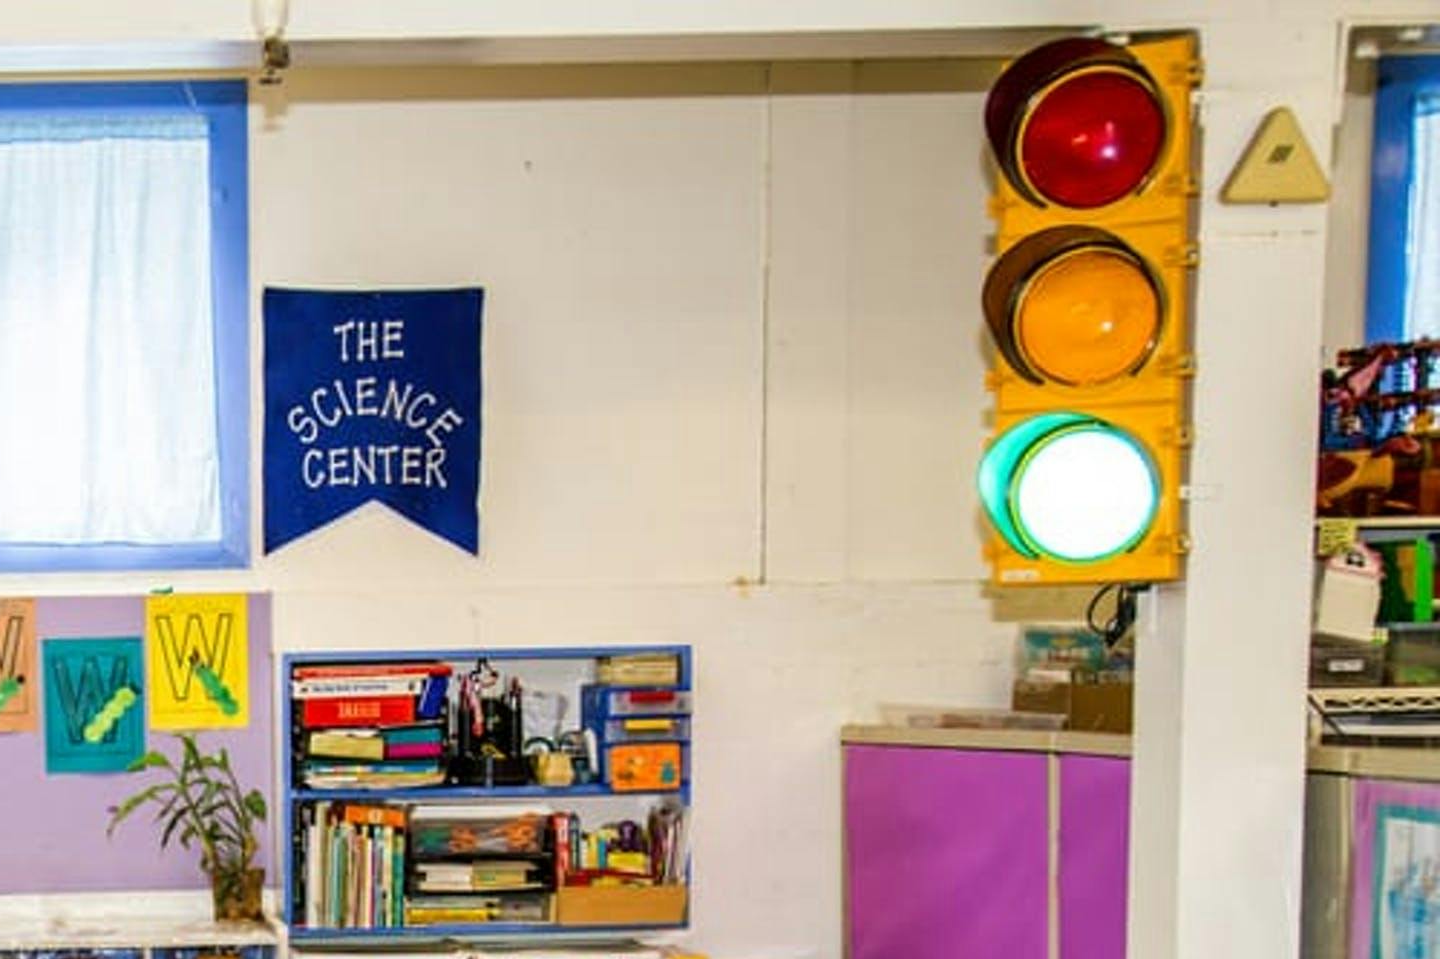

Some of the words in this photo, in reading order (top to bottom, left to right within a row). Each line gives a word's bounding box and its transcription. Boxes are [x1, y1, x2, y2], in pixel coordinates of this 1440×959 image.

[333, 320, 405, 363] THE
[287, 376, 463, 447] SCIENCE
[301, 444, 448, 489] CENTER
[155, 613, 233, 702] W
[50, 654, 129, 744] W
